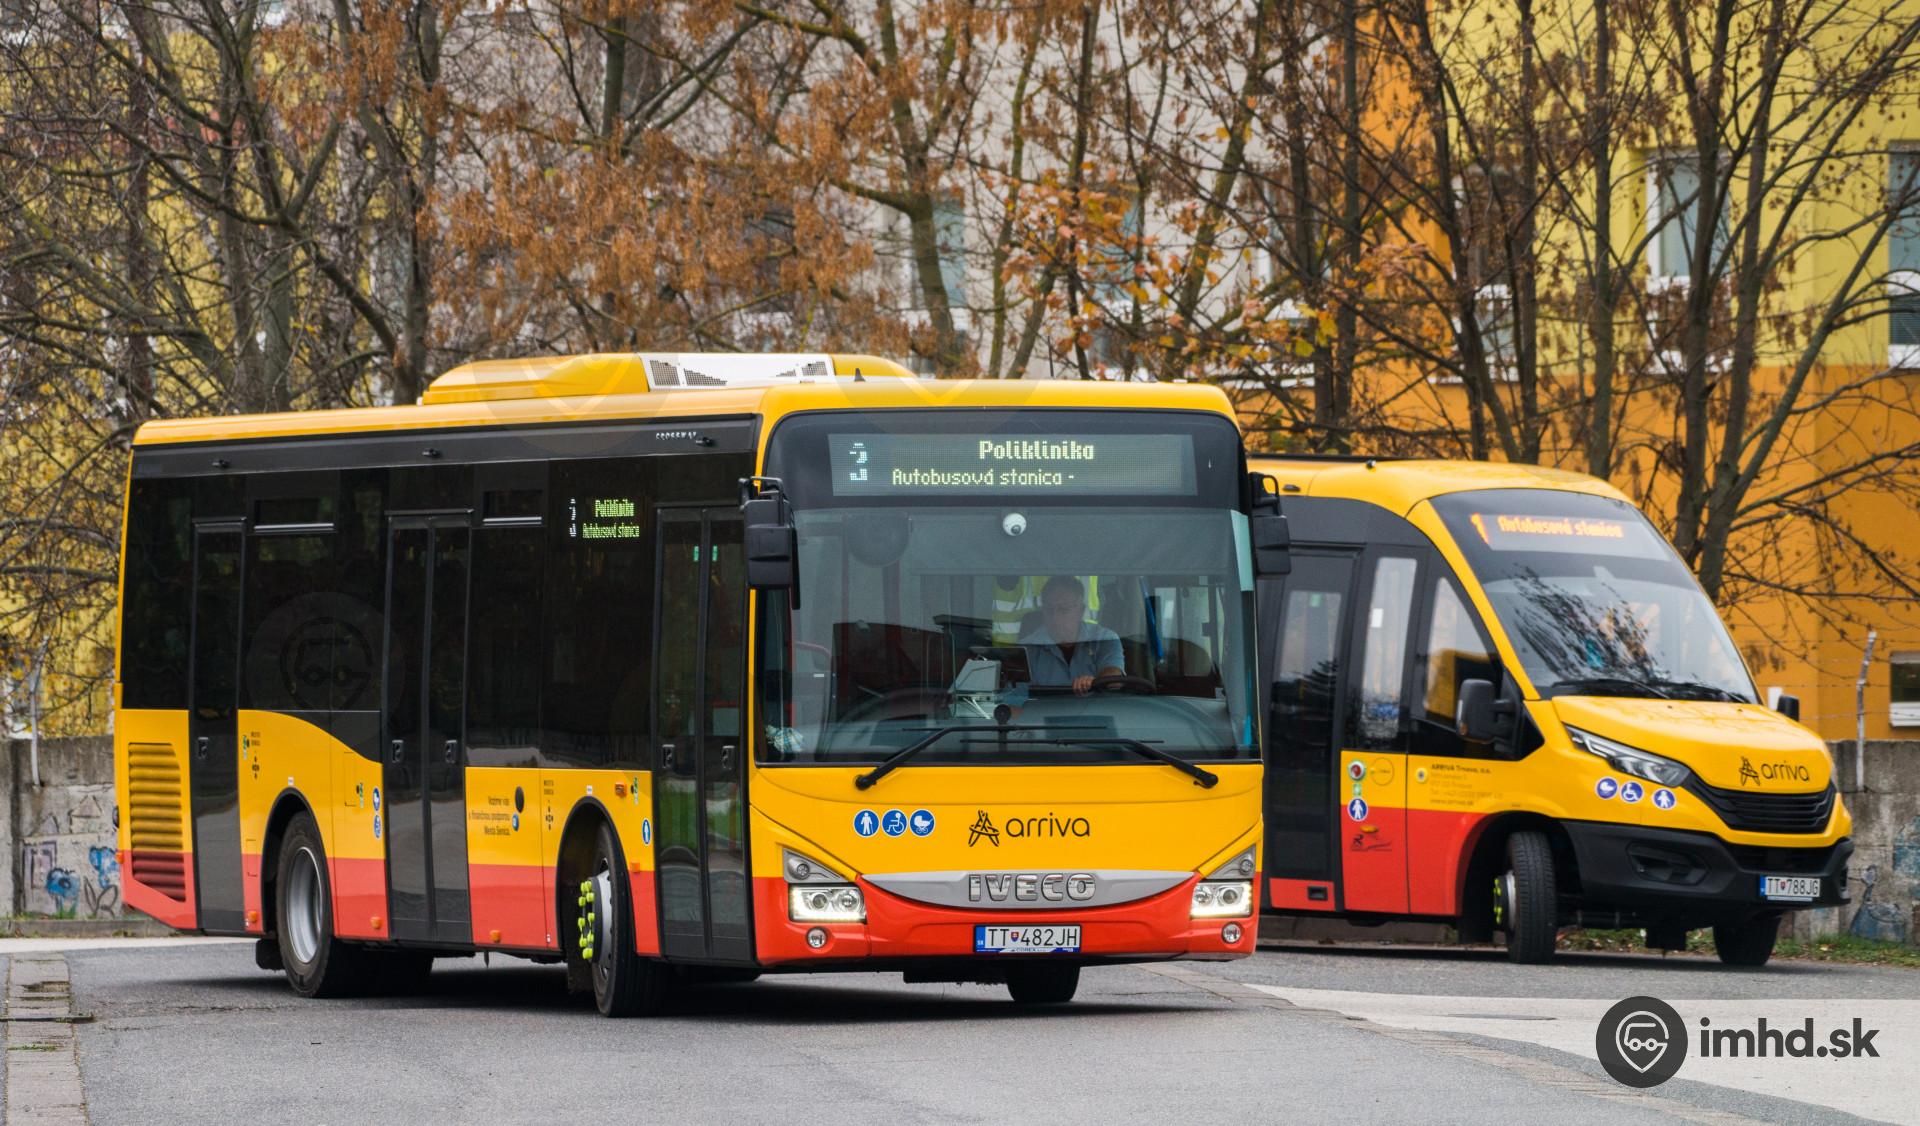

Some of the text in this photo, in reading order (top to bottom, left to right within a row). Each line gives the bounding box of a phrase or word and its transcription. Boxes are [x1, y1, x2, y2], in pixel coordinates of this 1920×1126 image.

[978, 440, 1095, 460] Poliklinika
[892, 468, 994, 486] Autobusová
[1000, 469, 1063, 485] stanica
[1761, 761, 1810, 783] arriva
[1005, 812, 1091, 838] arriva
[968, 873, 1097, 902] IVECO
[1767, 878, 1819, 896] TT 788JG
[987, 928, 1078, 947] TT 482JH
